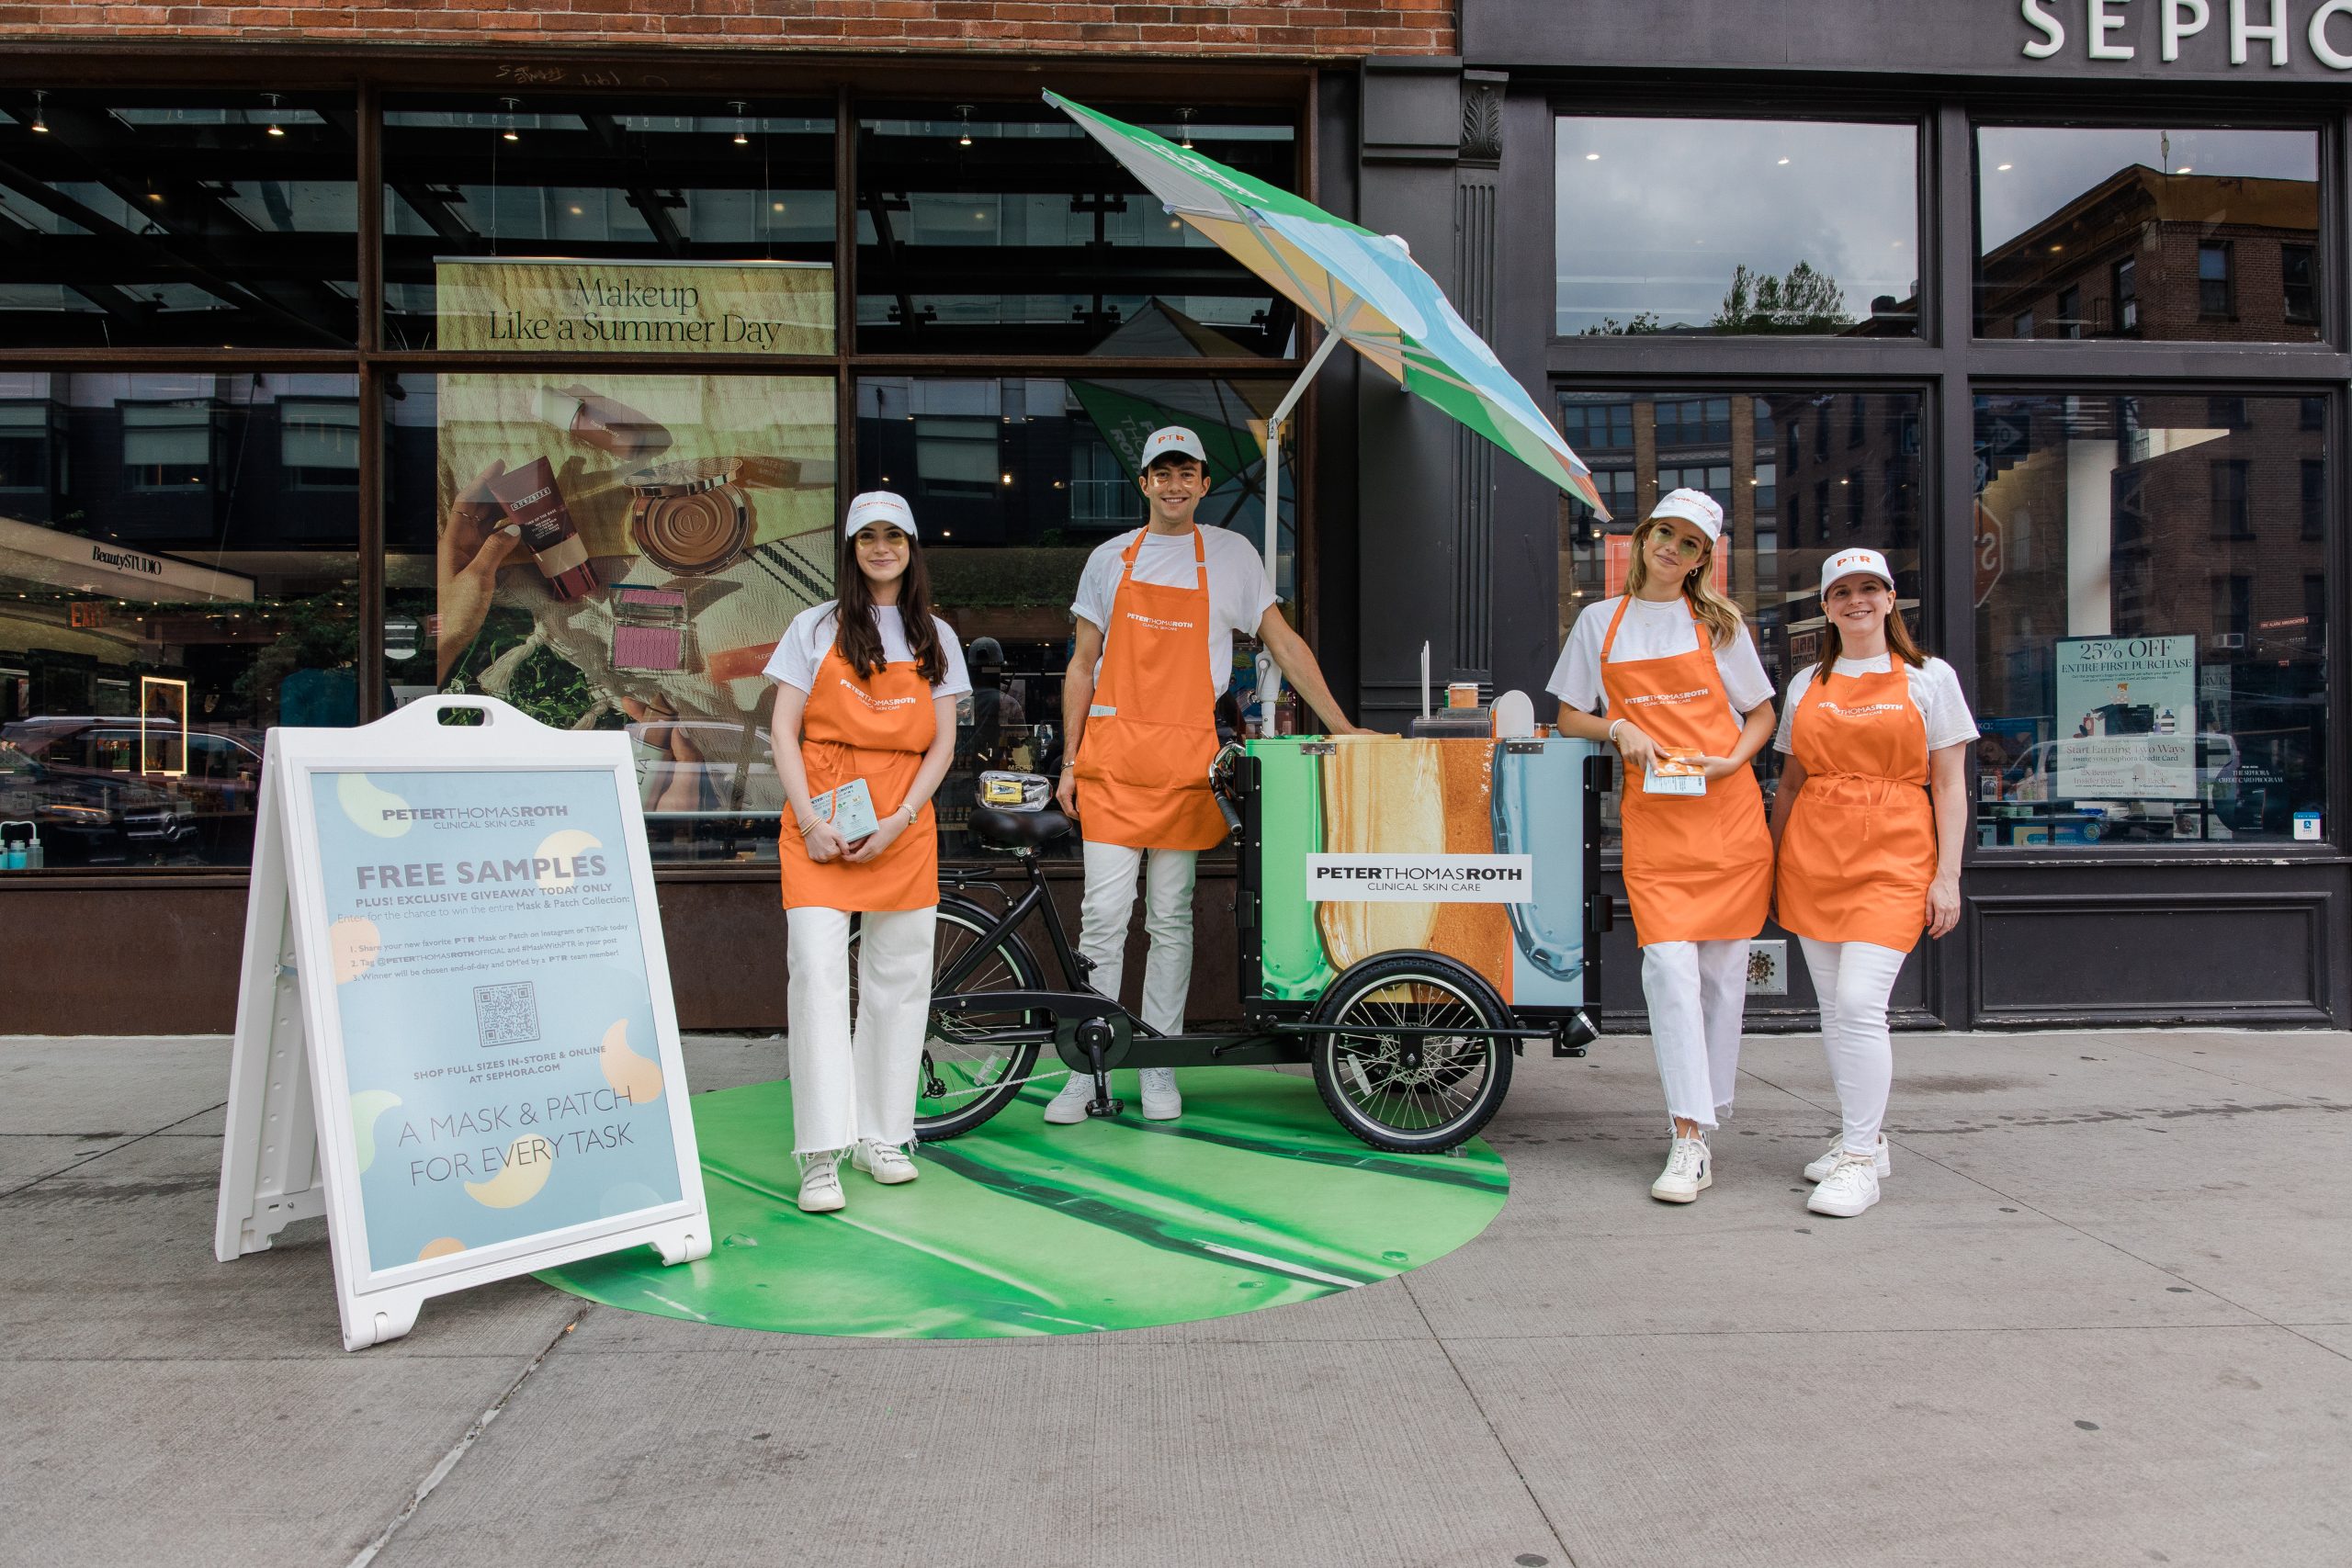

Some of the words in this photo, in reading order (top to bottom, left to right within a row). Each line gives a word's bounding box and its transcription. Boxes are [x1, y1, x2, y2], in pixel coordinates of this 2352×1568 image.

[572, 278, 698, 315] Makeup
[490, 310, 549, 341] Like
[558, 320, 574, 341] a
[582, 312, 715, 343] Summer
[724, 314, 783, 350] Day
[1158, 434, 1185, 444] PTR
[93, 546, 162, 575] BeautySTUDIO
[1838, 555, 1871, 567] PTR
[2080, 642, 2122, 660] 25%
[2062, 662, 2099, 673] ENTIRE
[2101, 661, 2129, 671] FIRST
[2132, 658, 2192, 671] PURCHASE
[2067, 745, 2089, 754] Start
[2158, 744, 2185, 755] Ways
[382, 805, 569, 821] PETERTHOMASROTH
[434, 821, 481, 830] CLINICAL
[484, 820, 507, 829] SKIN
[511, 819, 536, 828] CARE
[356, 863, 447, 890] FREE
[457, 854, 607, 885] SAMPLES
[1317, 866, 1522, 881] PETERTHOMASROTH
[356, 897, 393, 908] PLUS!
[397, 893, 468, 905] EXCLUSIVE
[470, 887, 536, 900] GIVEAWAY
[539, 885, 579, 896] TODAY
[582, 883, 612, 893] ONLY
[1367, 882, 1419, 891] CLINICAL
[1423, 883, 1448, 891] SKIN
[1451, 883, 1481, 892] CARE
[337, 914, 367, 924] Enter
[368, 911, 383, 921] for
[384, 910, 401, 920] the
[404, 908, 436, 919] chance
[439, 908, 449, 916] to
[452, 906, 469, 915] win
[471, 905, 486, 914] the
[489, 903, 514, 913] entire
[516, 900, 541, 910] Mask
[543, 900, 552, 908] &
[554, 898, 579, 908] Patch
[582, 896, 630, 906] Collection:
[384, 943, 402, 952] your
[422, 938, 452, 948] favorite
[478, 934, 496, 942] Mask
[509, 931, 528, 940] Patch
[541, 927, 575, 937] Instagram
[585, 925, 608, 933] TikTok
[610, 924, 629, 932] today
[360, 959, 375, 968] Tag
[586, 939, 601, 948] your
[603, 937, 617, 946] post
[362, 971, 392, 981] Winner
[394, 969, 408, 977] will
[410, 968, 420, 976] be
[422, 966, 448, 975] chosen
[451, 962, 489, 972] end-of-day
[491, 960, 504, 968] and
[589, 950, 619, 959] member!
[413, 1068, 445, 1080] SHOP
[447, 1064, 474, 1076] FULL
[477, 1060, 505, 1071] SIZES
[508, 1053, 557, 1066] IN-STORE
[559, 1051, 566, 1059] &
[569, 1045, 606, 1058] ONLINE
[469, 1074, 481, 1084] AT
[487, 1064, 560, 1081] SEPHORA.COM
[399, 1122, 421, 1147] A
[430, 1104, 513, 1143] MASK
[519, 1102, 538, 1125] &
[547, 1085, 632, 1121] PATCH
[410, 1153, 474, 1186] FOR
[481, 1134, 564, 1172] EVERY
[568, 1122, 634, 1155] TASK
